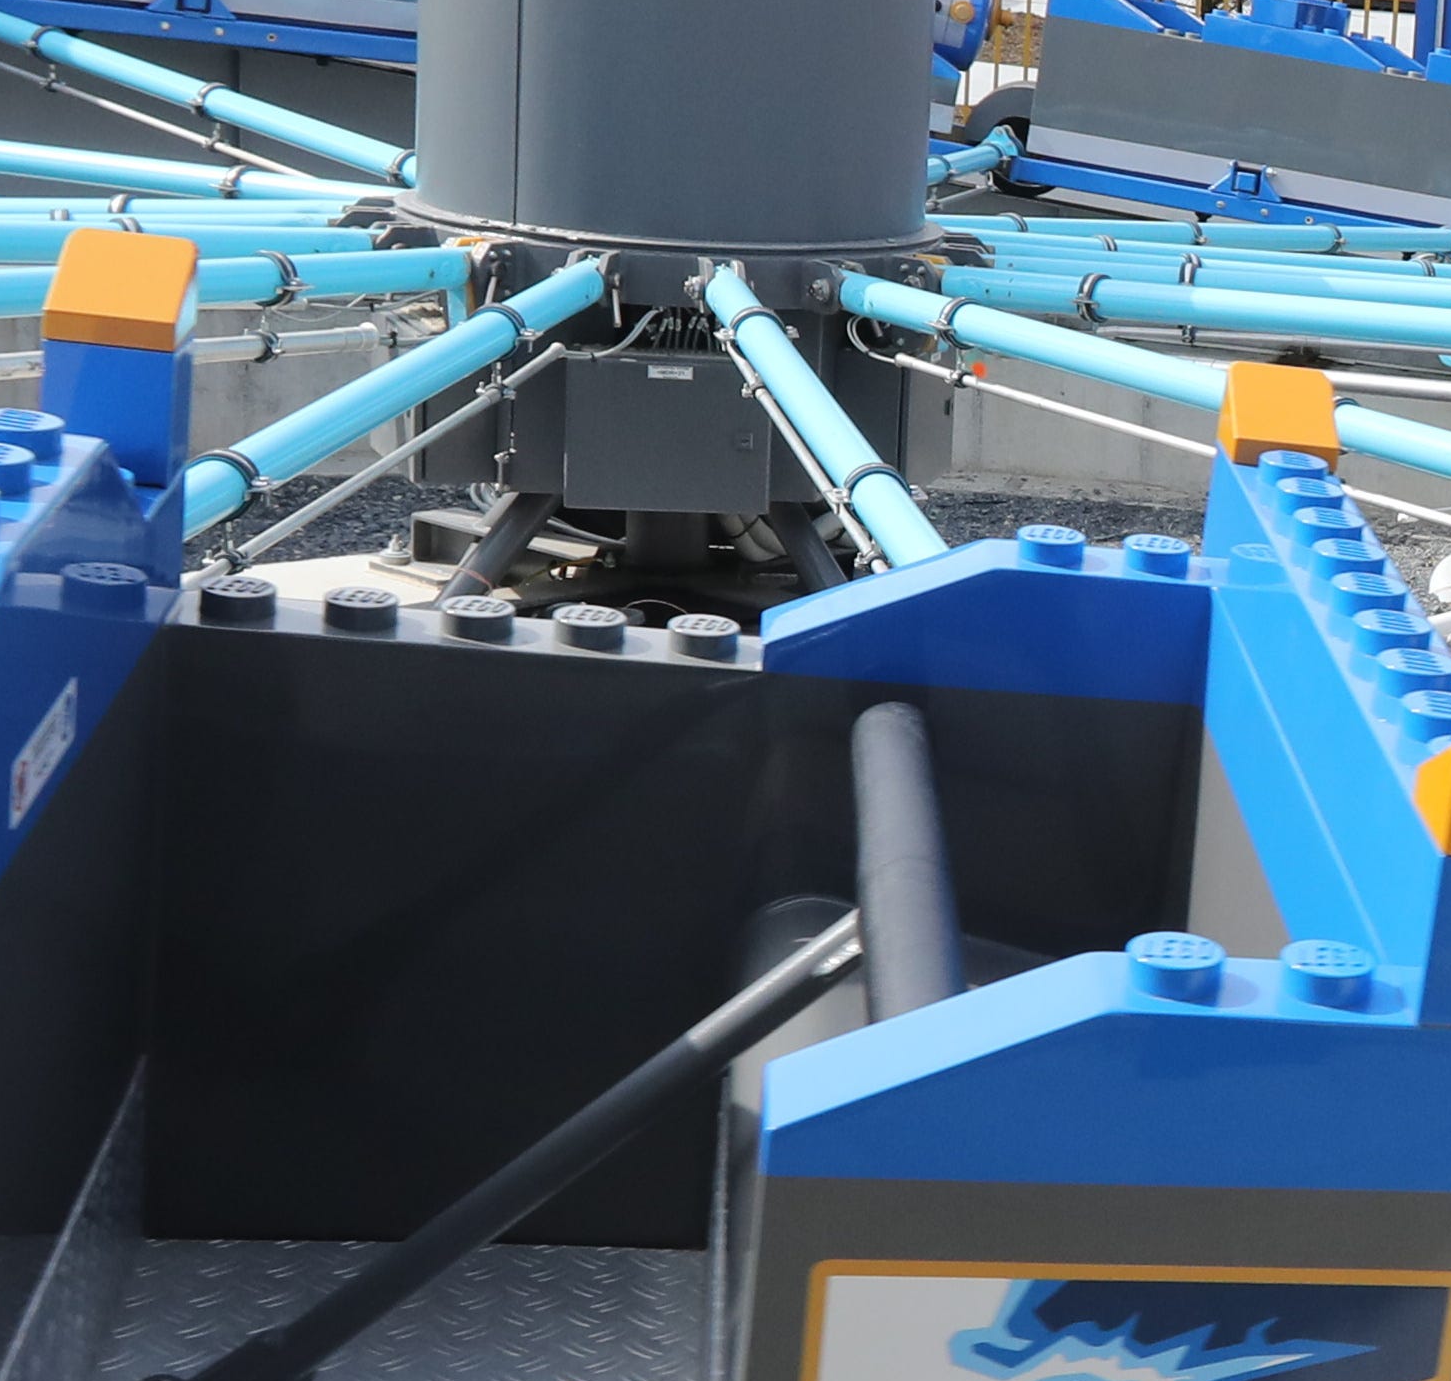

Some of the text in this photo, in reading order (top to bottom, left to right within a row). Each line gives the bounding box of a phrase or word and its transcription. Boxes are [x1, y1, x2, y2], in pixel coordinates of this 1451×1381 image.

[205, 578, 272, 595] LEGO
[327, 588, 393, 605] LEGO
[448, 598, 510, 614] LEGO
[564, 607, 620, 623] LEGO
[676, 616, 734, 632] LEGO
